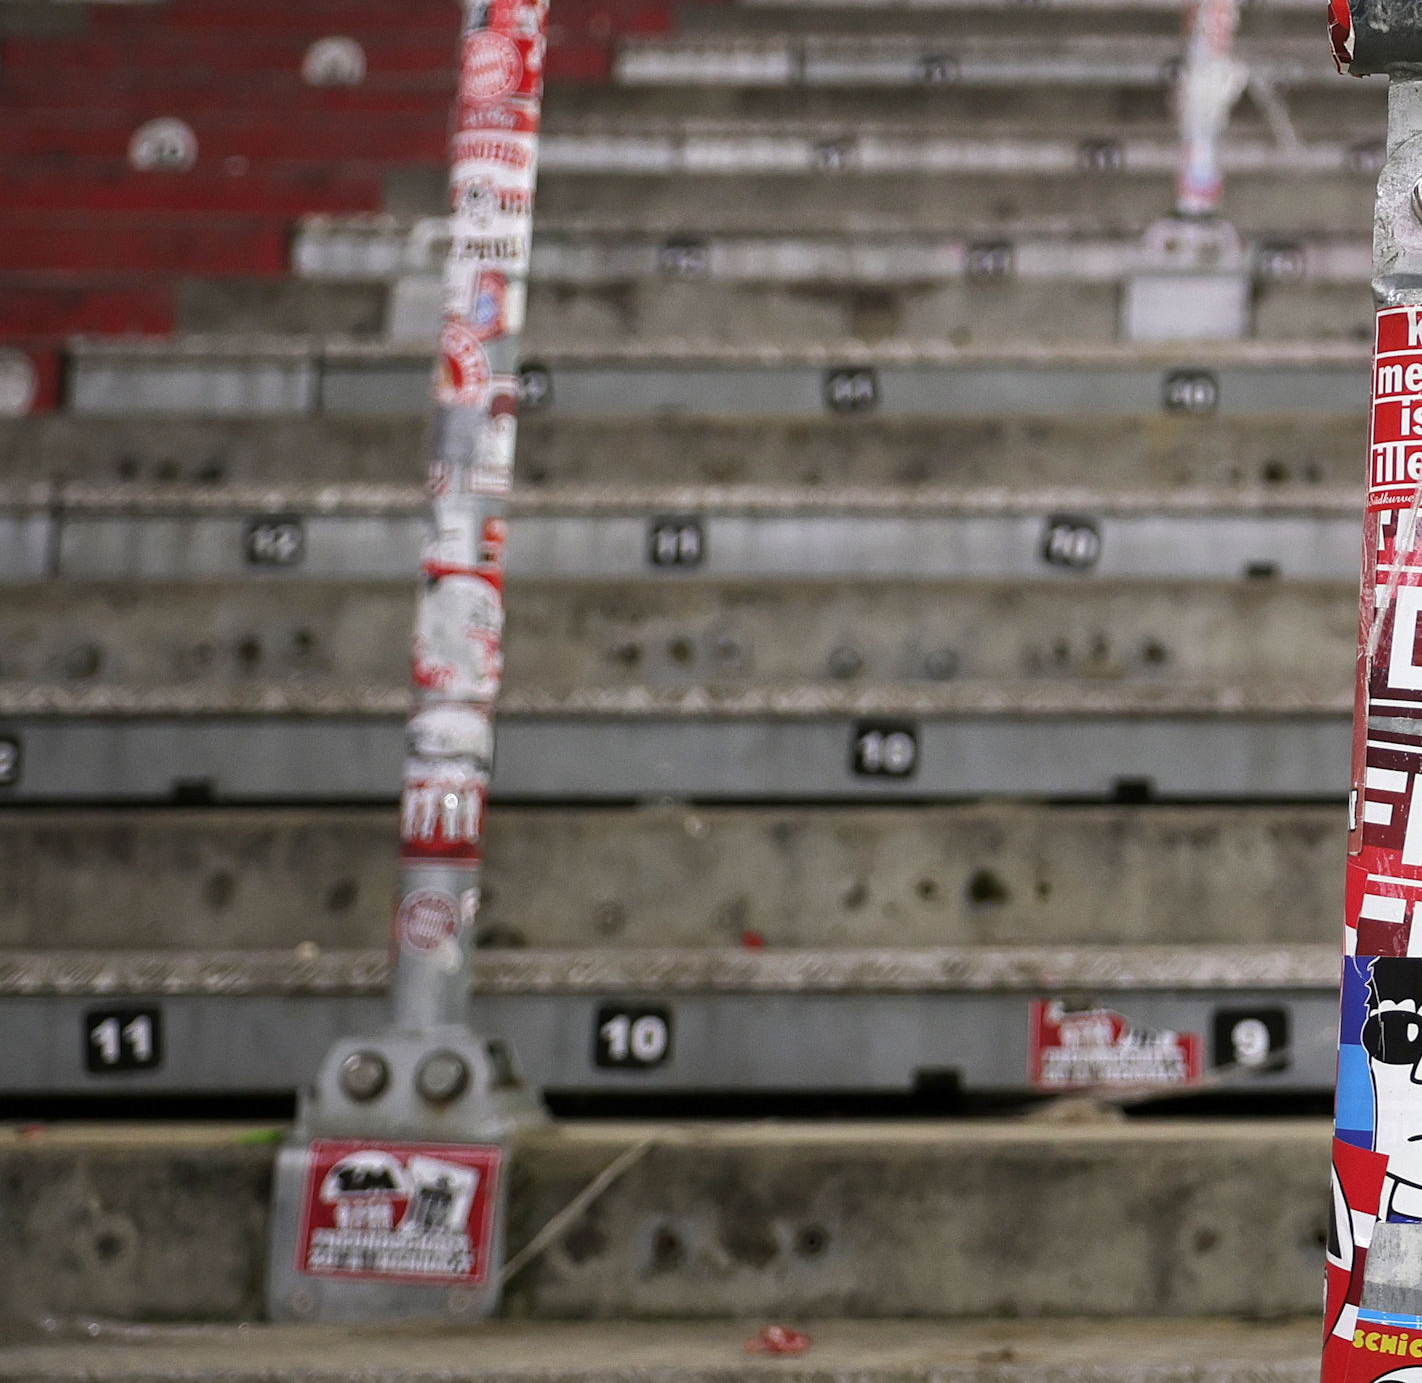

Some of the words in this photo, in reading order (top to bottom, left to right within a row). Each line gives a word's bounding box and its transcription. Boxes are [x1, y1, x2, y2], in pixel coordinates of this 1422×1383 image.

[858, 730, 912, 774] 10
[91, 1016, 153, 1064] 11
[601, 1015, 670, 1063] 10
[1231, 1018, 1270, 1067] 9
